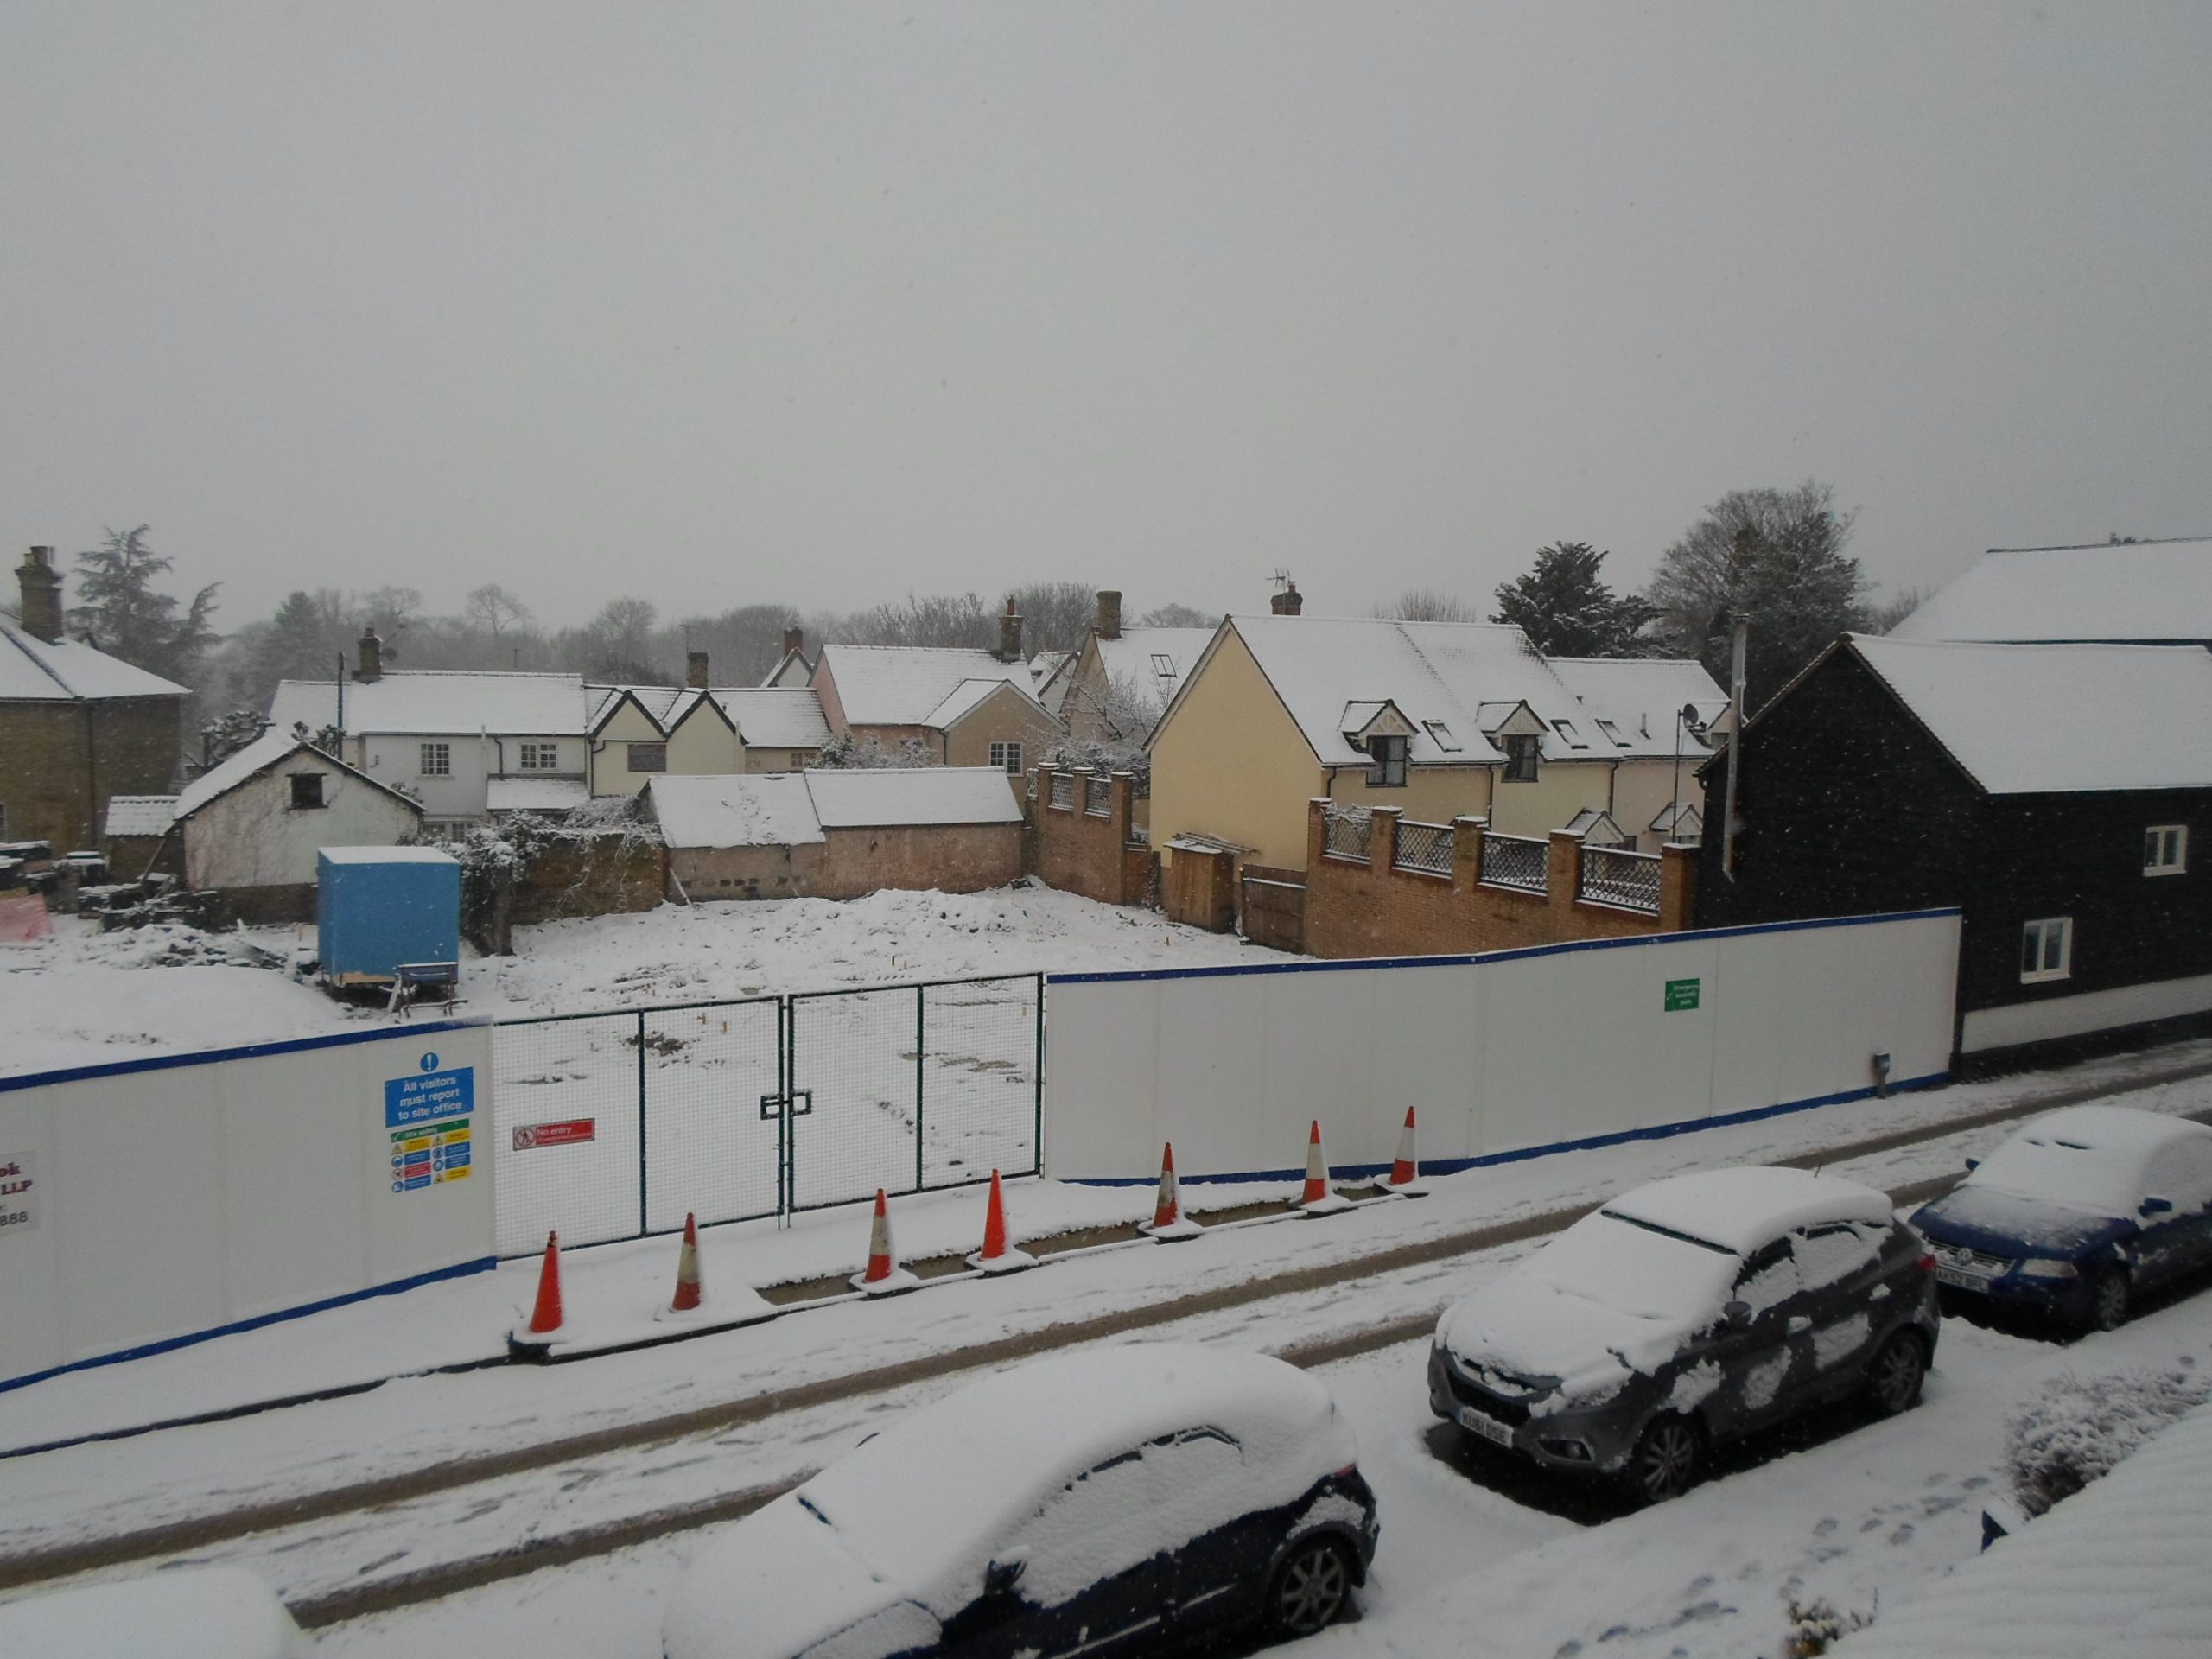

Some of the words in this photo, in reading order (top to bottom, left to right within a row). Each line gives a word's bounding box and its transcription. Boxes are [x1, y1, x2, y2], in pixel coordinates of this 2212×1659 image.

[403, 1082, 416, 1093] All
[419, 1077, 456, 1090] visitors
[400, 1095, 426, 1107] must
[429, 1088, 460, 1103] report
[398, 1110, 409, 1120] to
[412, 1107, 430, 1118] site
[433, 1101, 462, 1114] office
[550, 1126, 572, 1135] entry
